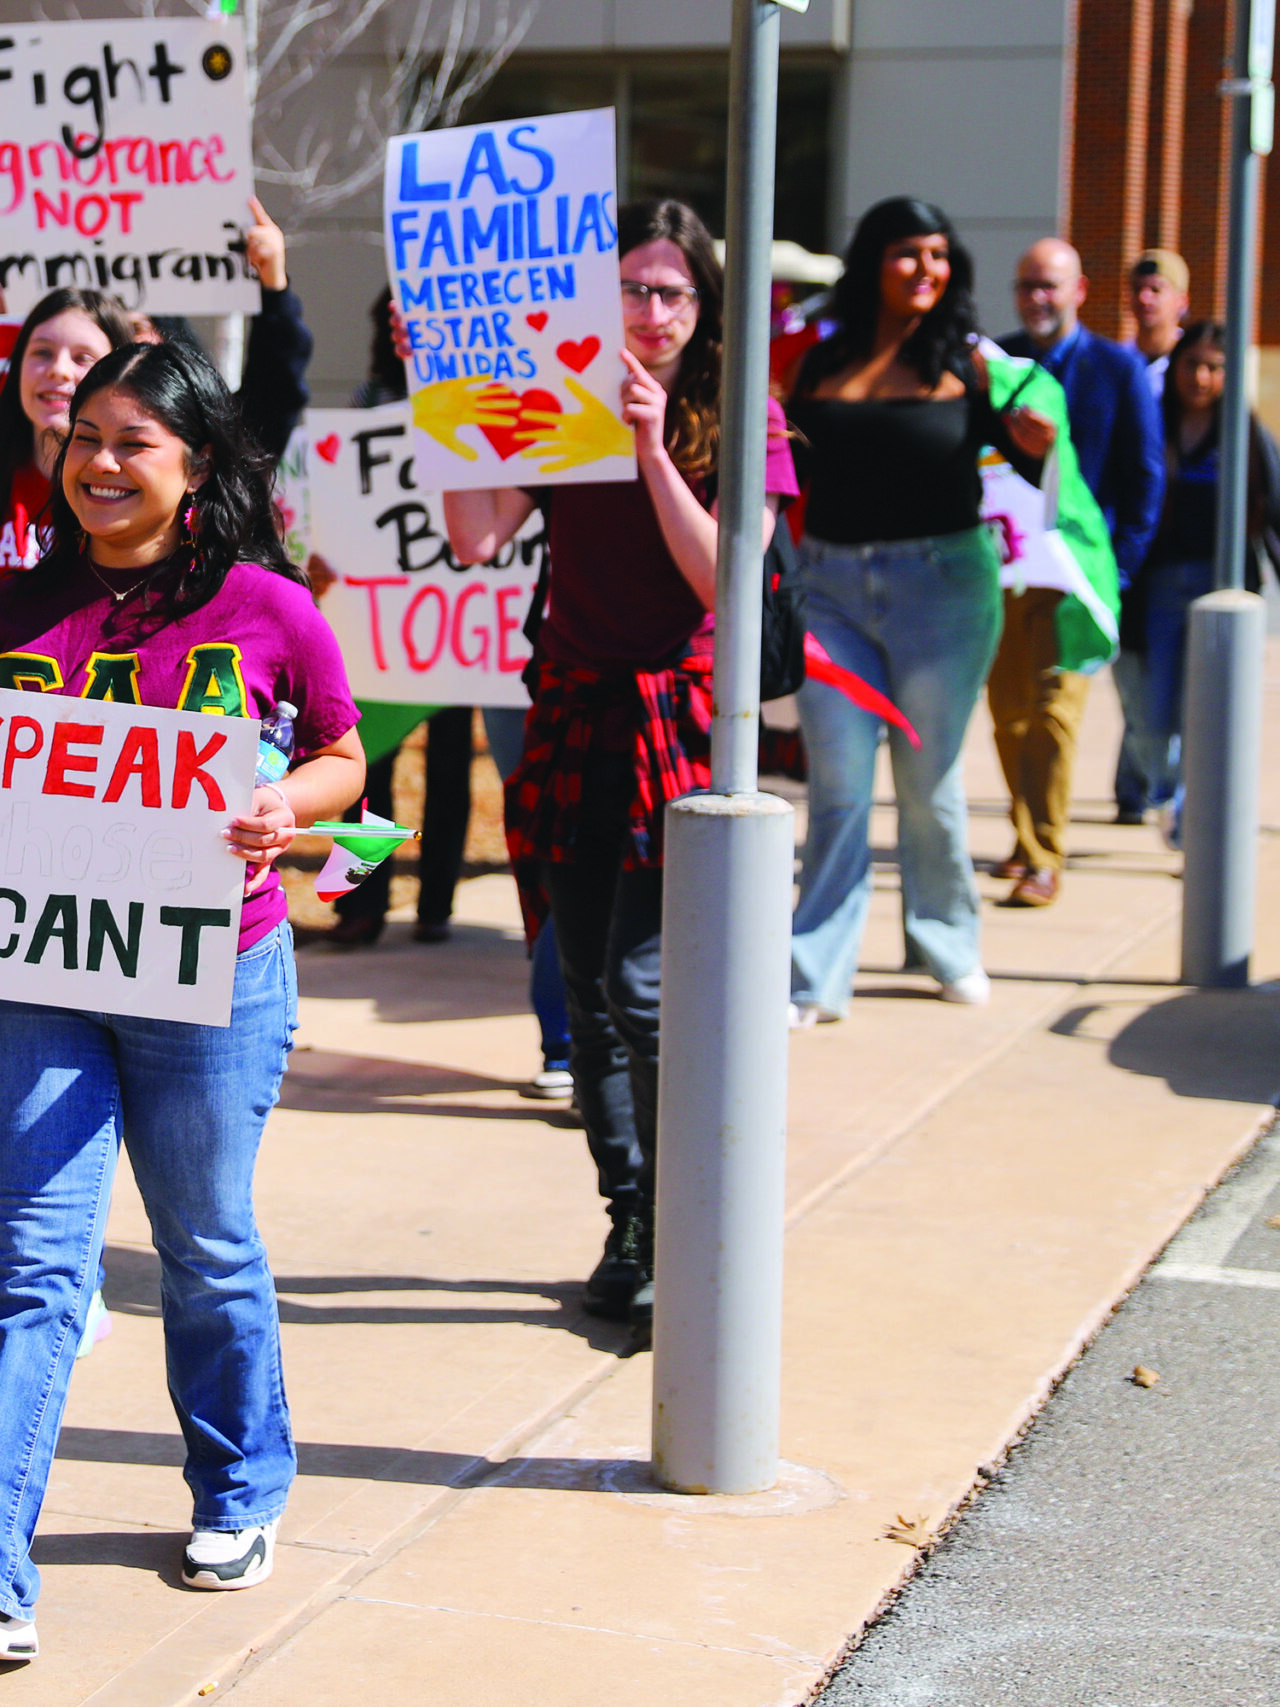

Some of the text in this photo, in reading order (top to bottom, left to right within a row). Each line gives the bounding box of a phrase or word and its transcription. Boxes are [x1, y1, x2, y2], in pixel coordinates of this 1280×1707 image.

[399, 124, 556, 202] LAS
[33, 190, 144, 237] NOT
[391, 191, 619, 271] FAMILIAS
[397, 263, 577, 314] MERECEN
[407, 311, 518, 351] ESTAR
[412, 348, 538, 384] UNIDAS
